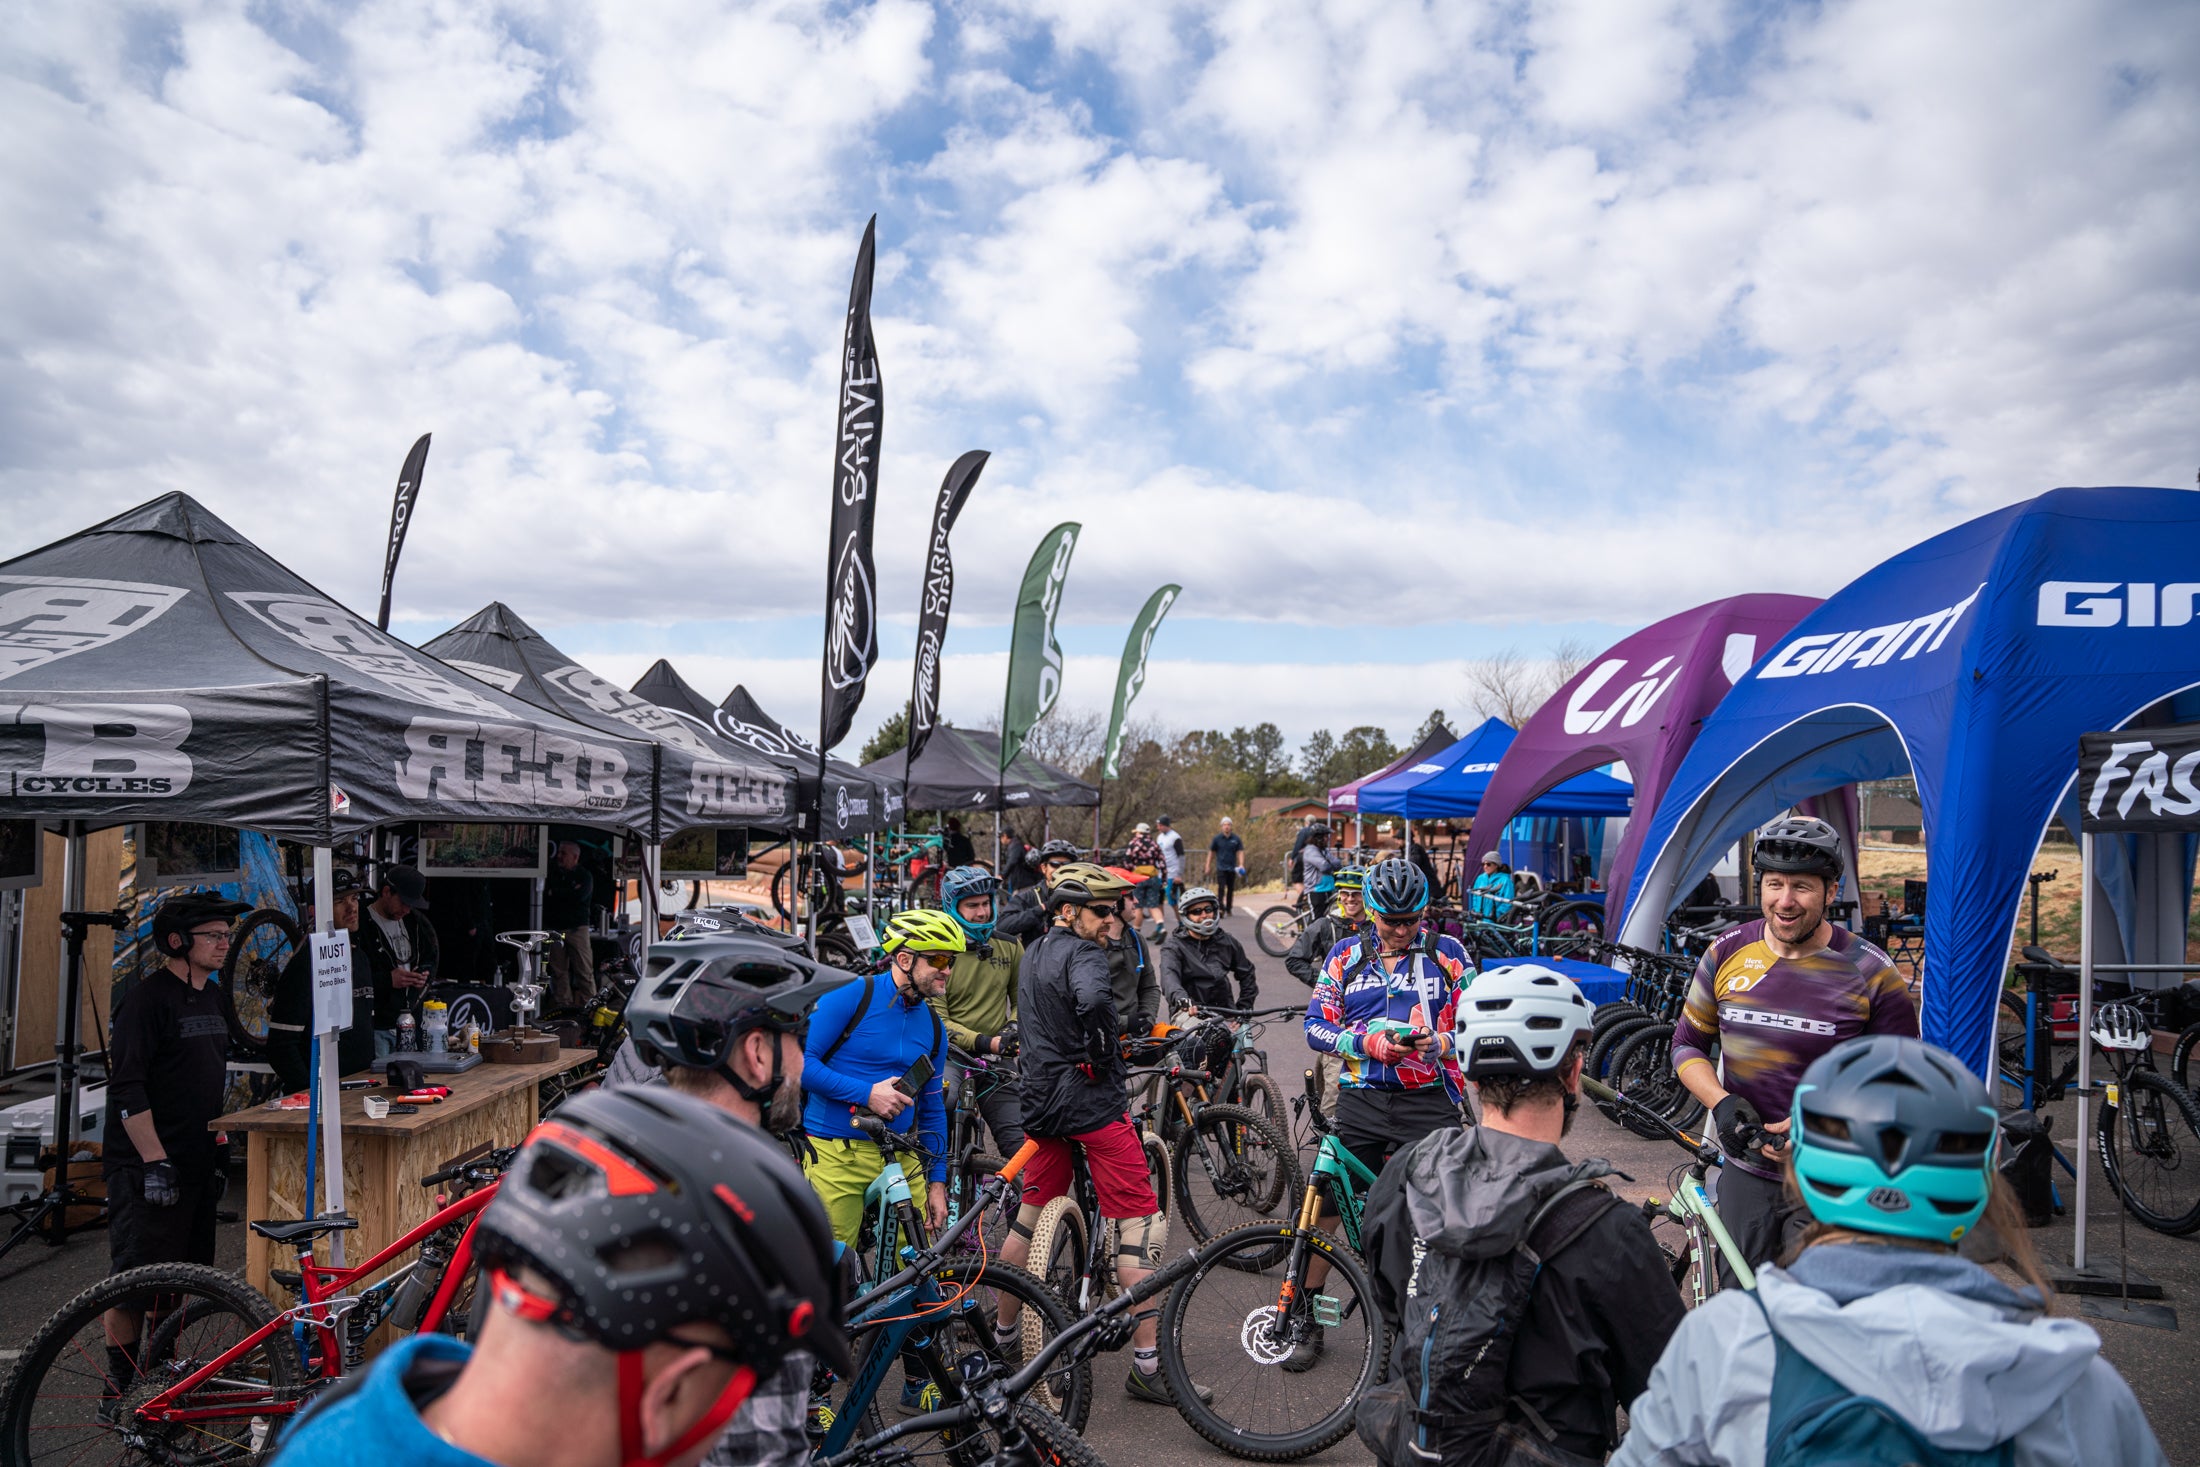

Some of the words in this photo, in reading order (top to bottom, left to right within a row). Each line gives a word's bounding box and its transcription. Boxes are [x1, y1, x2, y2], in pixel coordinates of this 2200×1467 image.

[1756, 581, 1988, 680] GIANT
[395, 716, 629, 810] REEB
[22, 776, 172, 794] CYCLES
[588, 797, 622, 809] CYCLES
[320, 943, 345, 960] MUST
[1744, 957, 1763, 965] Here
[318, 968, 331, 977] Have
[331, 965, 342, 974] Pass
[342, 964, 348, 972] To
[319, 979, 334, 988] Demo
[1722, 1007, 1837, 1036] REEB
[1307, 1023, 1338, 1044] MAPEI
[1480, 1037, 1505, 1045] GIRO
[2100, 1131, 2111, 1169] MAXXIS
[841, 1327, 893, 1421] FEZZARI
